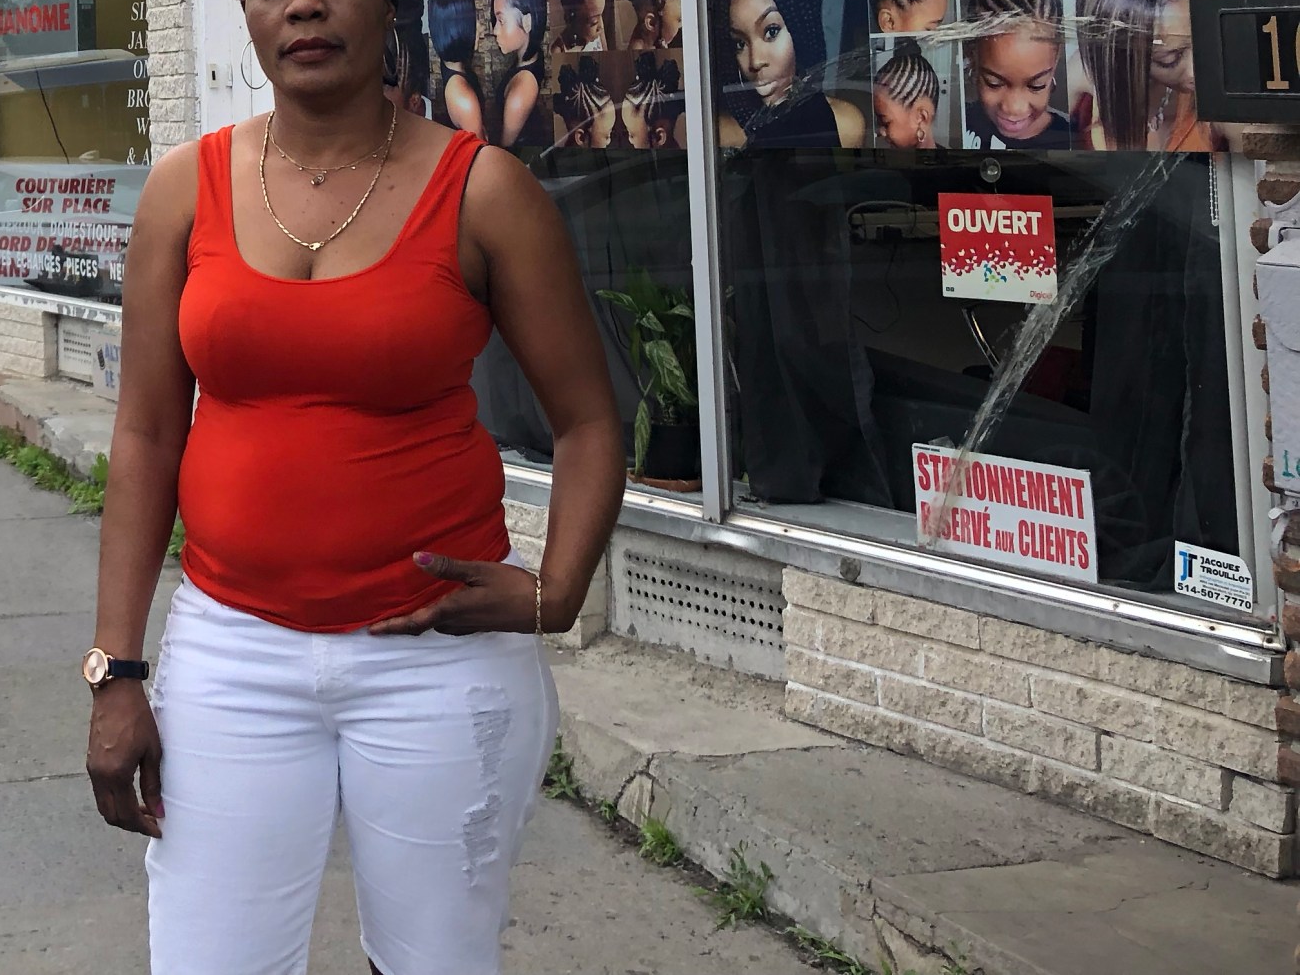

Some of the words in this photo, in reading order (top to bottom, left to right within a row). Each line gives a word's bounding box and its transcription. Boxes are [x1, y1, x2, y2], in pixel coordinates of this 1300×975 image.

[1262, 15, 1300, 89] 1
[127, 147, 136, 165] &
[15, 173, 116, 194] COUTURIÈRE
[22, 198, 54, 213] SUR
[62, 198, 111, 214] PLACE
[947, 208, 1042, 236] OUVERT
[36, 236, 57, 252] DE
[61, 236, 122, 253] PANTAL
[66, 257, 98, 278] PIECES
[995, 529, 1015, 553] AUX
[1018, 519, 1090, 570] CLIENTS
[1200, 556, 1240, 572] JACQUES
[1200, 565, 1251, 584] TROUILLOT
[1177, 582, 1252, 609] 514-507-7770
